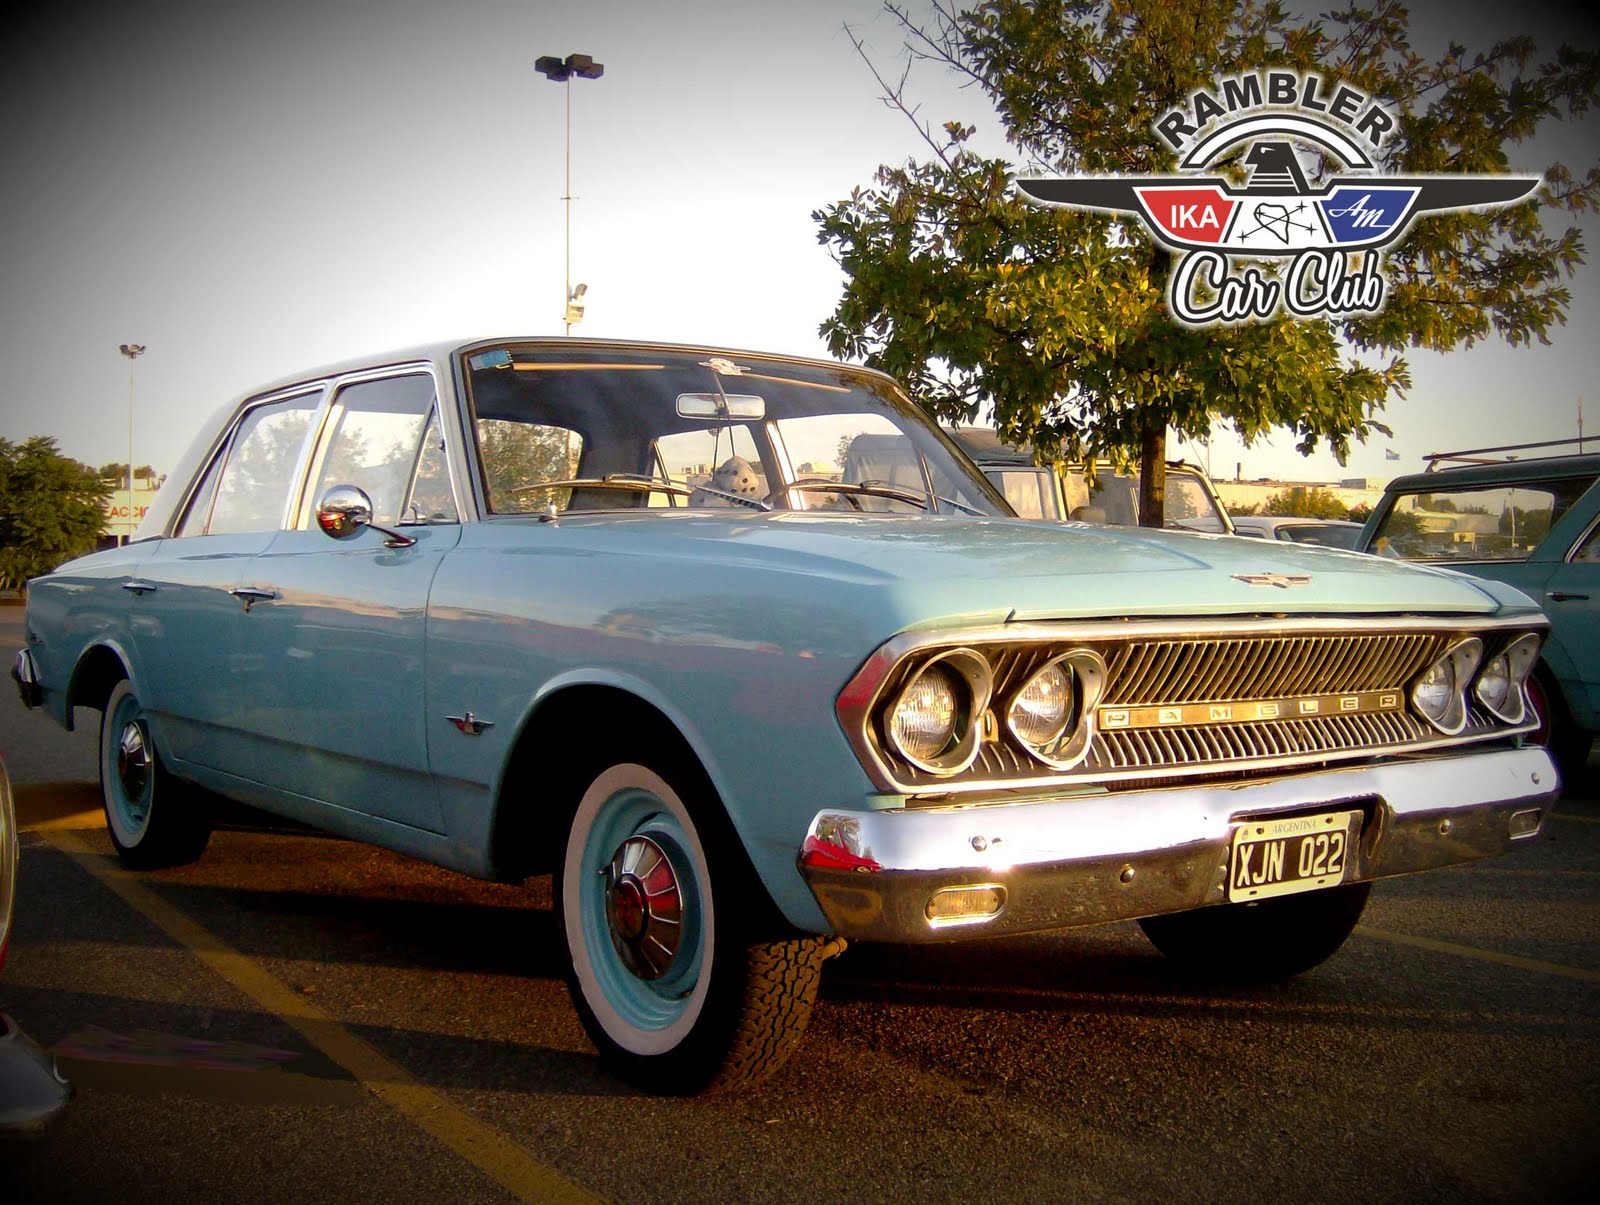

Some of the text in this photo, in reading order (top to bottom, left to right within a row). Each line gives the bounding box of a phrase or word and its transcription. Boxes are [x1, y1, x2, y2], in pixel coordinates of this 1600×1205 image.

[1272, 820, 1317, 834] ARGENTINA
[1236, 832, 1344, 887] XJN 022
